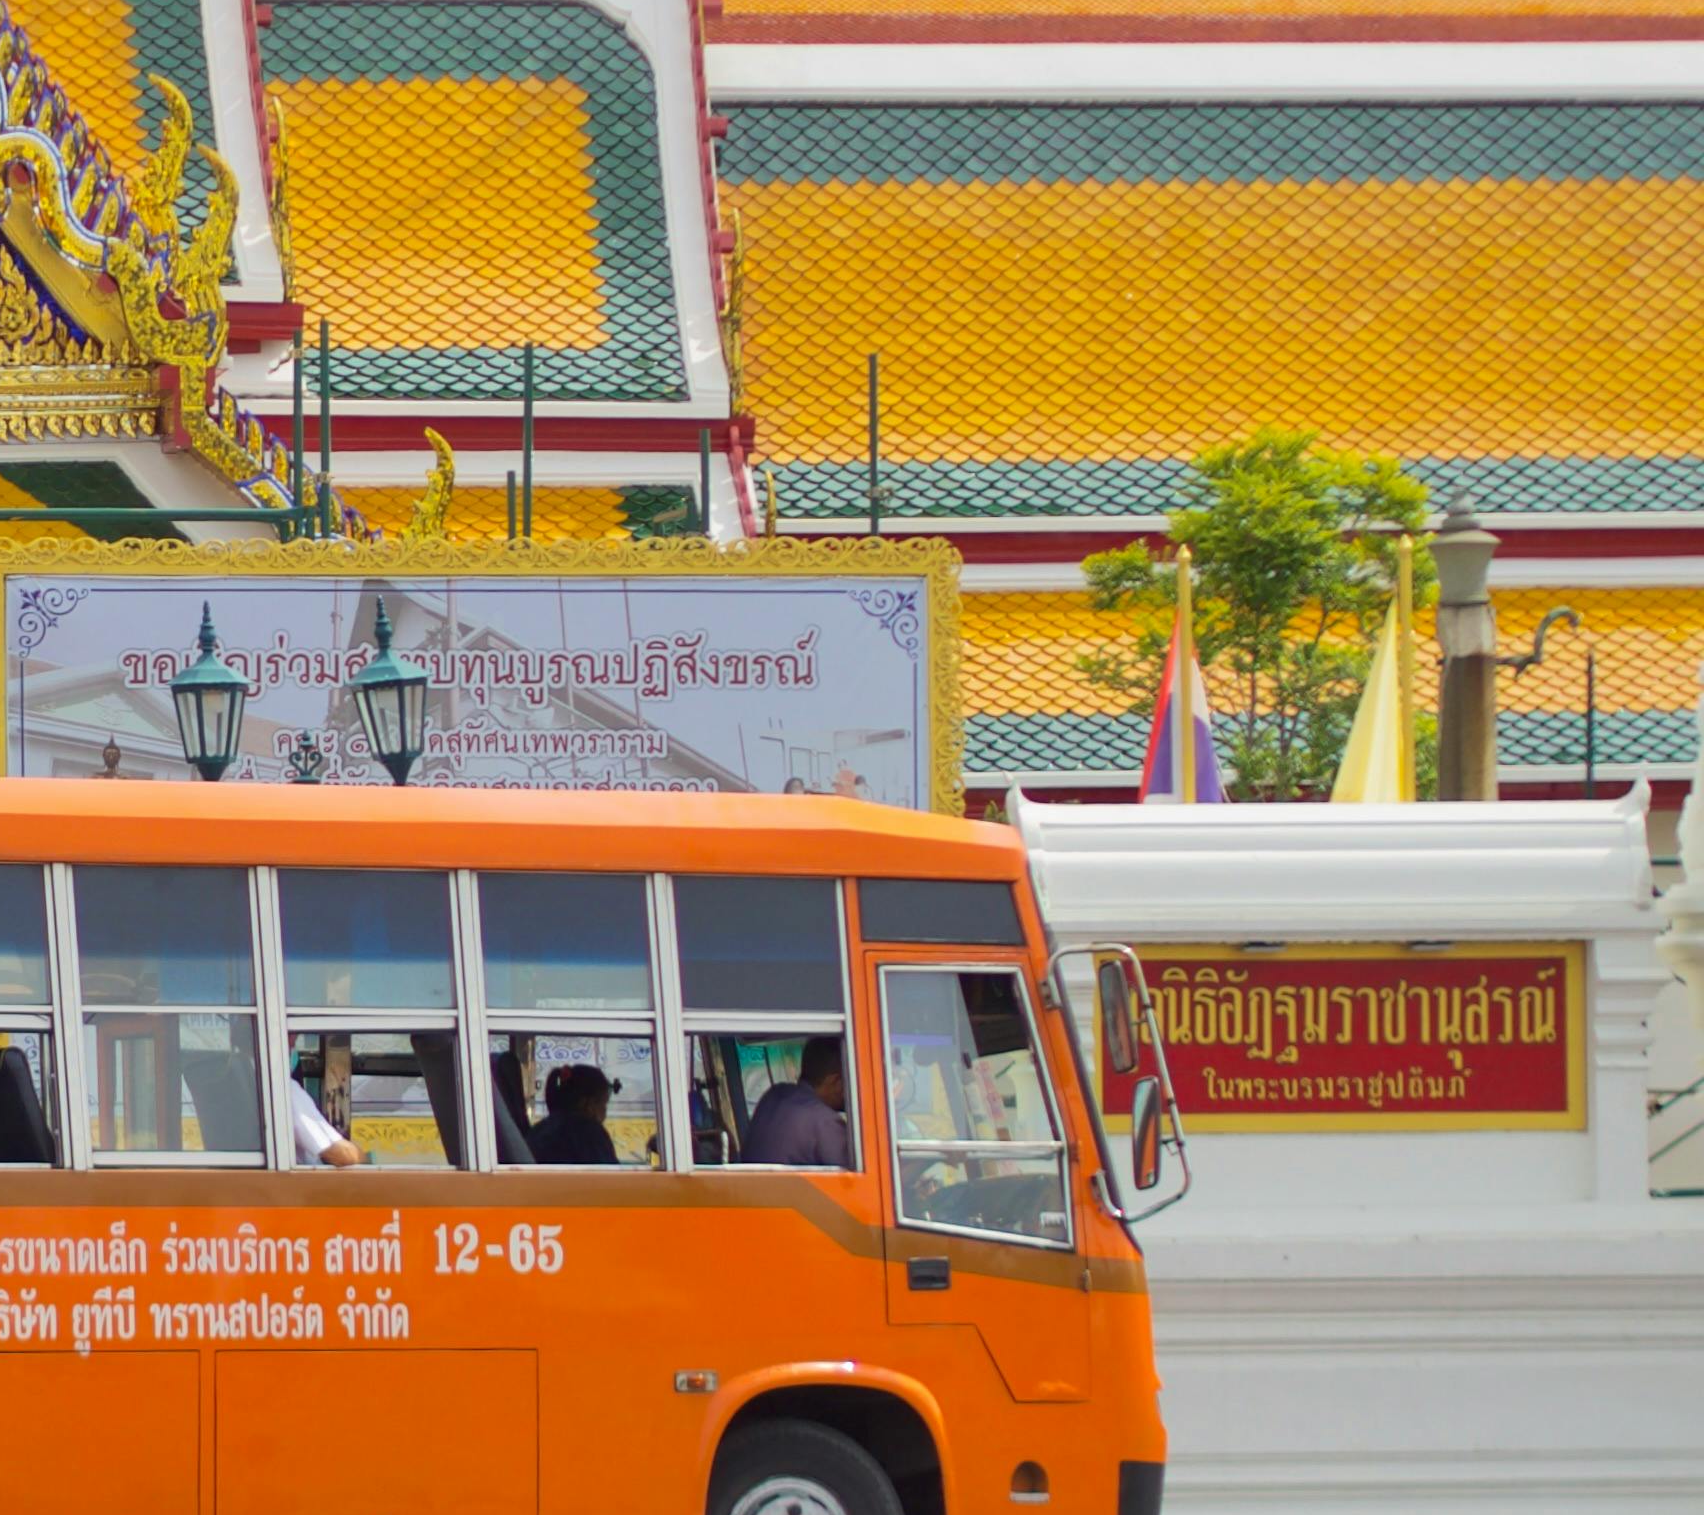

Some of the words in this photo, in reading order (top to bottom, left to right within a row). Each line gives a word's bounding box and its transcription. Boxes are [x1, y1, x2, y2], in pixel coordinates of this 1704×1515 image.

[1129, 967, 1557, 1071] ลนิธิอัฏฐมราชานุสรณ์
[161, 1221, 310, 1274] ร่วมบริการ
[324, 1209, 402, 1274] สายที่
[433, 1222, 565, 1274] 12-65
[149, 1286, 323, 1340] ทรานสปอร์ต
[337, 1286, 410, 1340] จำกัด
